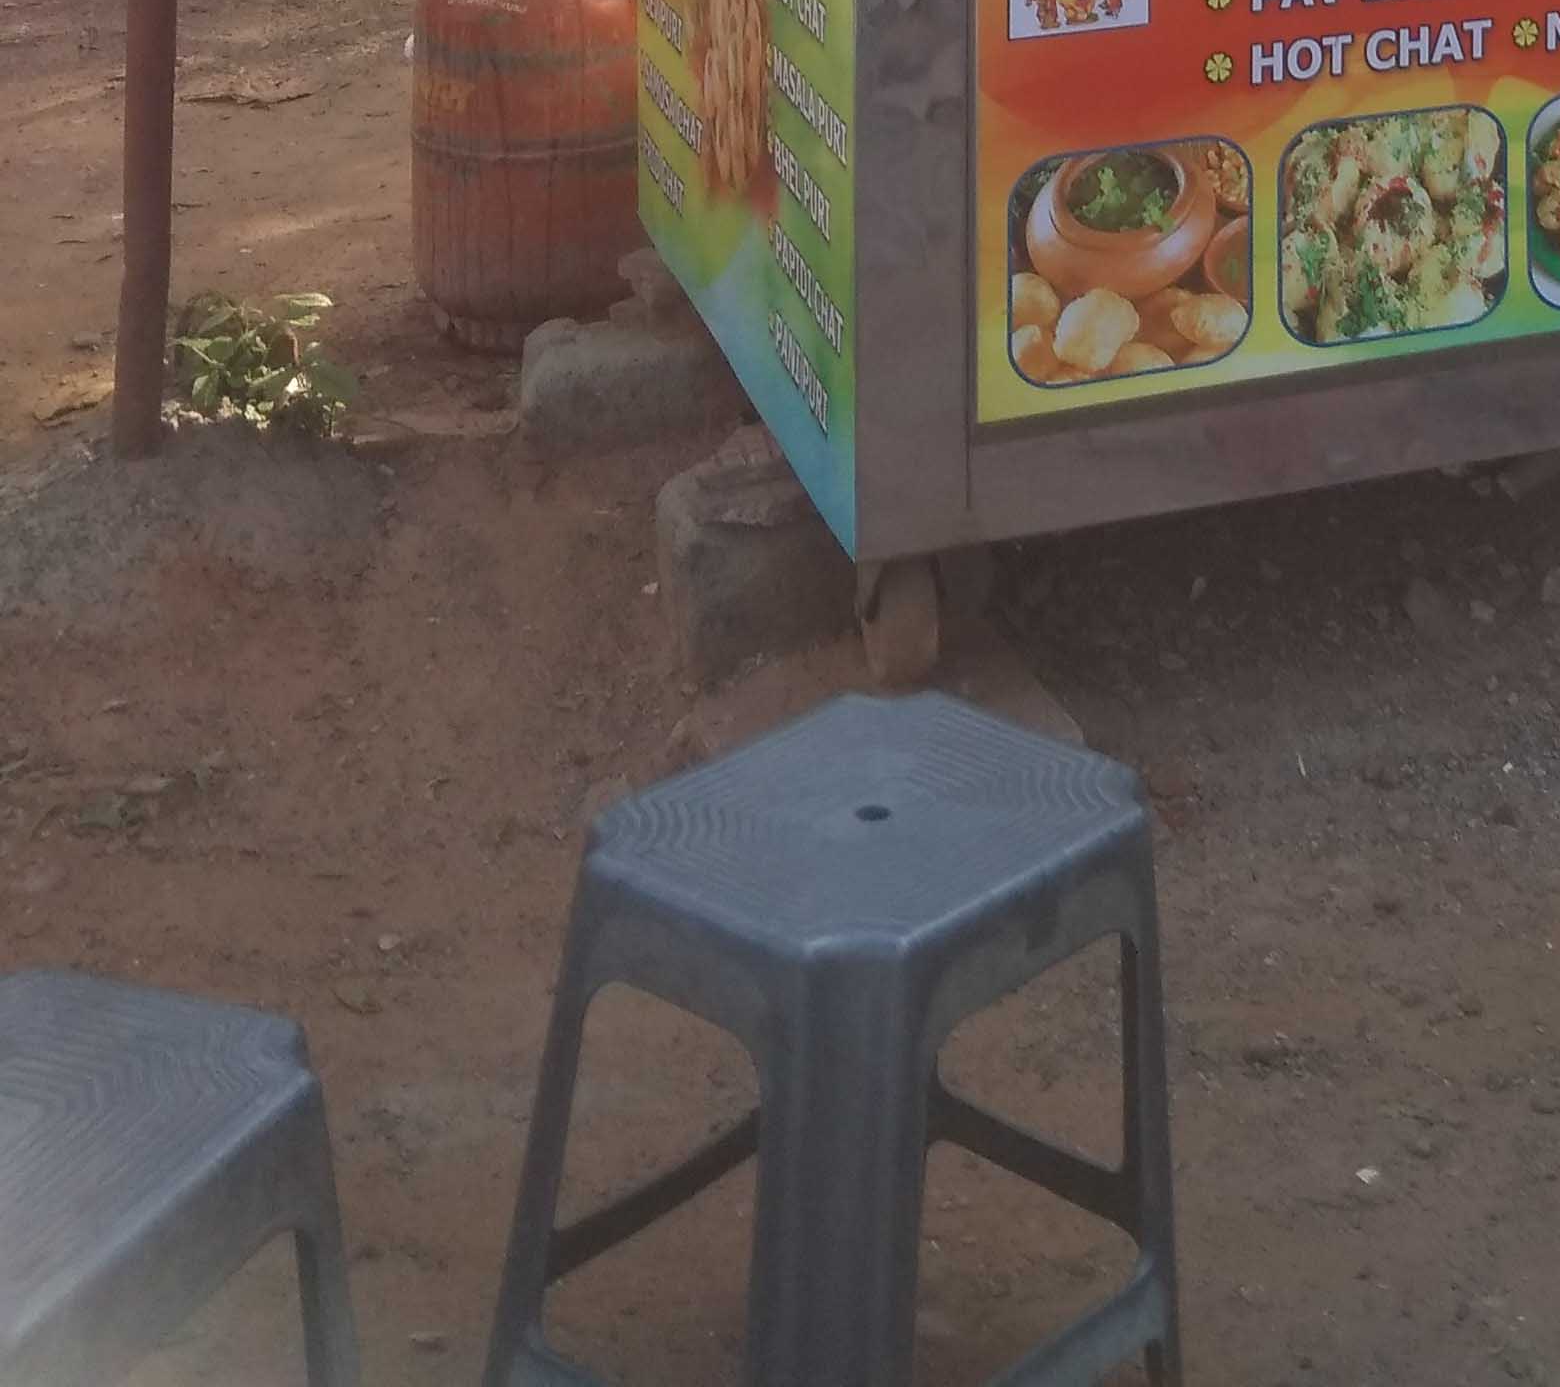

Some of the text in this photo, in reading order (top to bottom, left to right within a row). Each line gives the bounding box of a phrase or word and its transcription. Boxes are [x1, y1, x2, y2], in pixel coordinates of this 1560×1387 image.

[772, 44, 849, 169] MASALA PURI
[1248, 33, 1354, 86] HOT
[1365, 18, 1494, 73] CHAT
[677, 101, 703, 154] CHAT
[661, 159, 685, 217] CHAT
[773, 131, 832, 244] BHEL PURI
[774, 223, 844, 355] PAPIDI CHAT
[775, 314, 830, 438] PANI PURI
